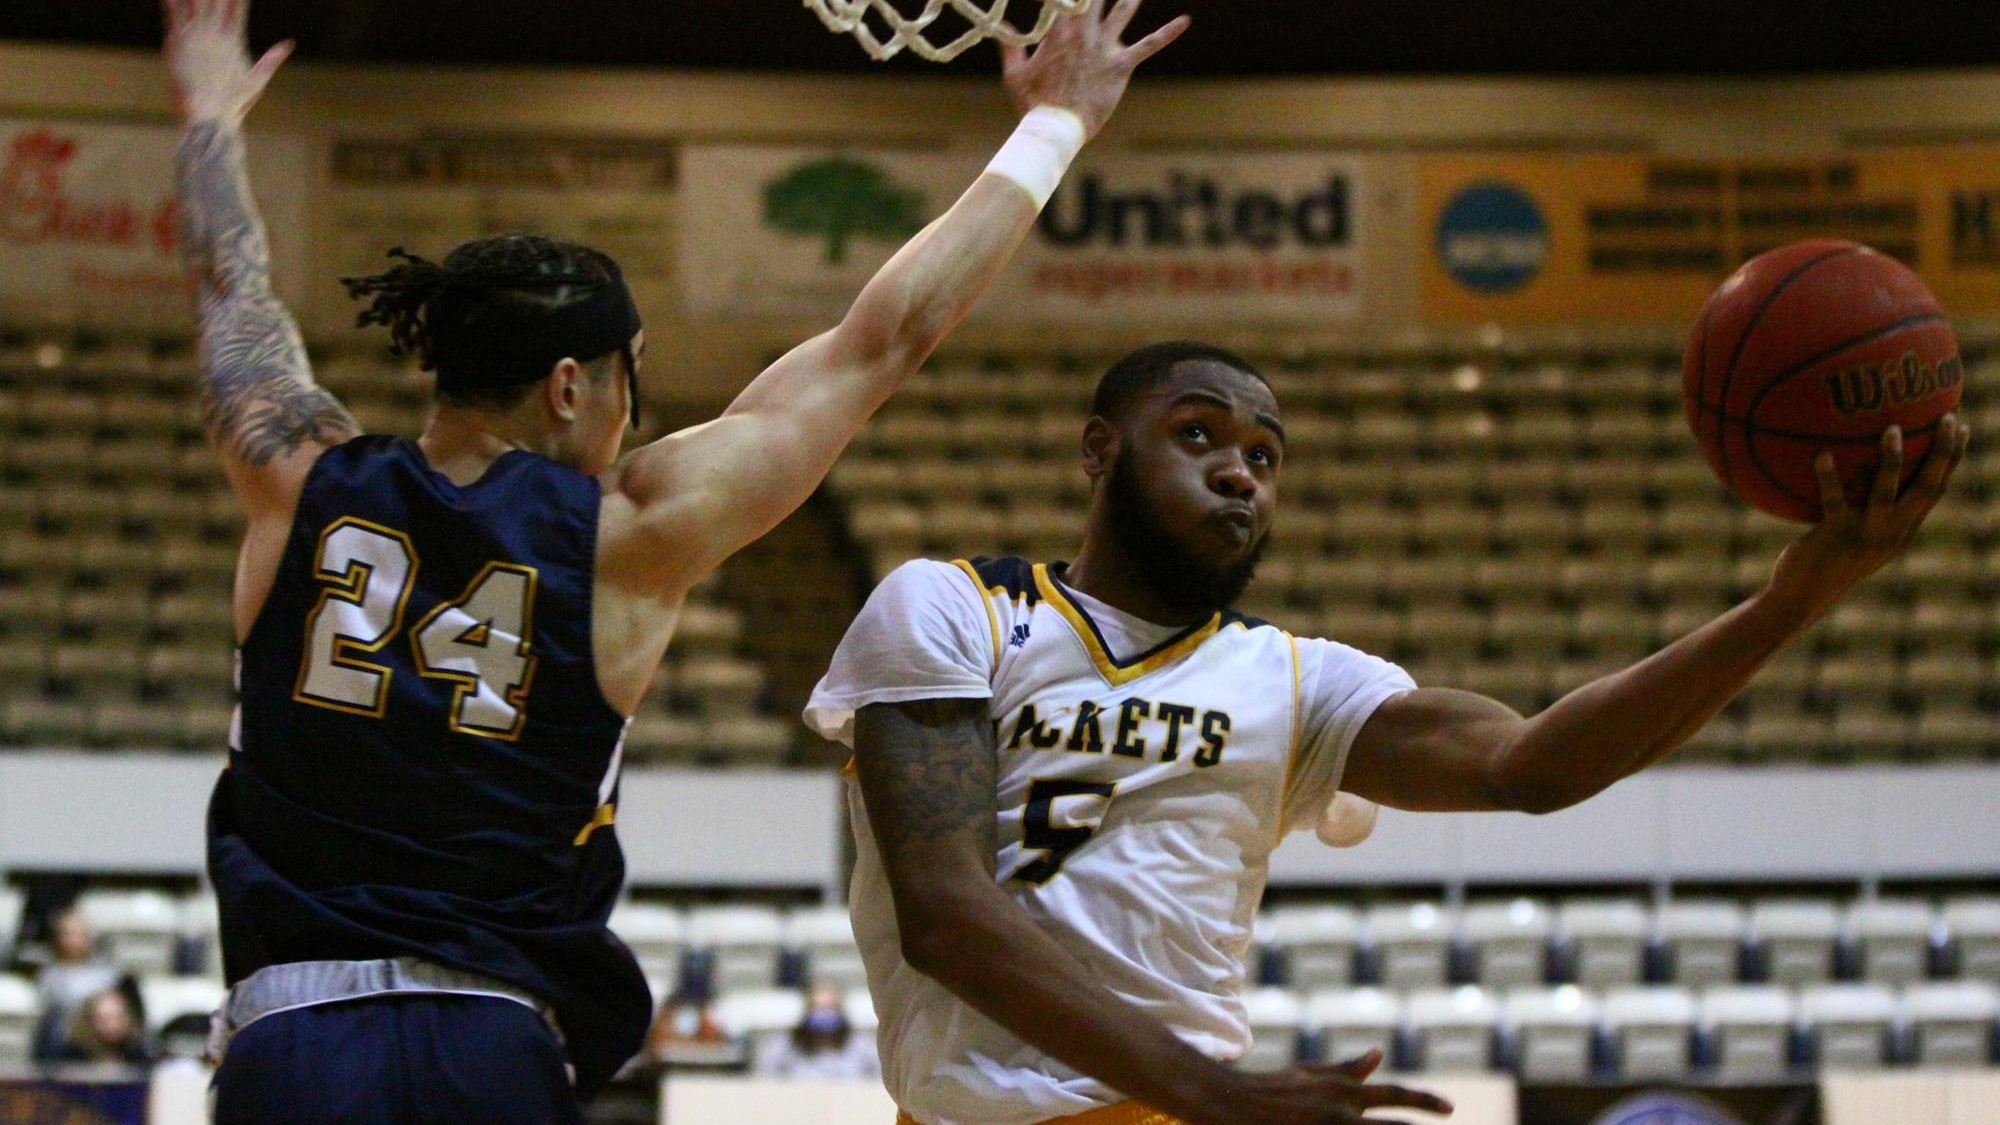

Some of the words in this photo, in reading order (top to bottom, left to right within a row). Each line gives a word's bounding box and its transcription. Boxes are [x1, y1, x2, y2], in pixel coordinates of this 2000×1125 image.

[292, 516, 538, 741] 24
[994, 697, 1232, 768] ACKETS
[1011, 777, 1120, 885] 5
